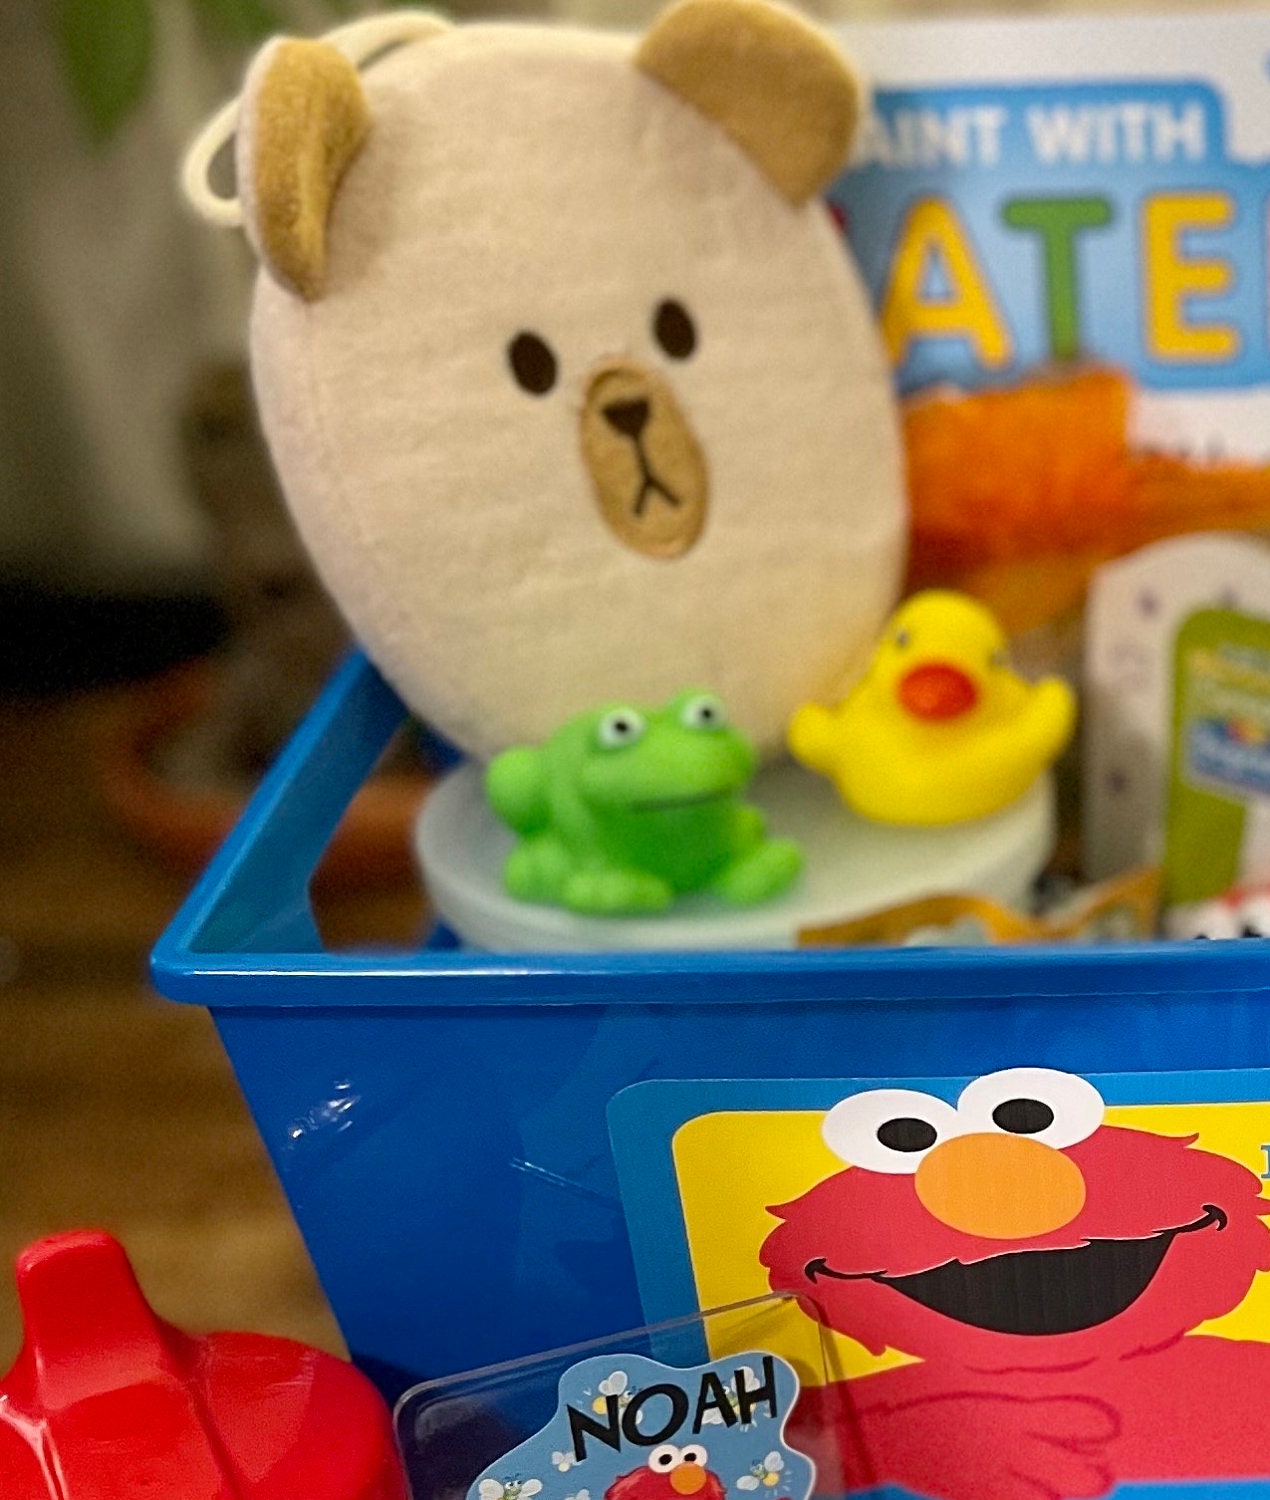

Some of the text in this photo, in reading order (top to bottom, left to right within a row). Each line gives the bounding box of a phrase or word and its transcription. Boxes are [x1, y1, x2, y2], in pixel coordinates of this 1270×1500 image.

[850, 101, 1205, 168] AINT WITH
[566, 1355, 778, 1462] NOAH
